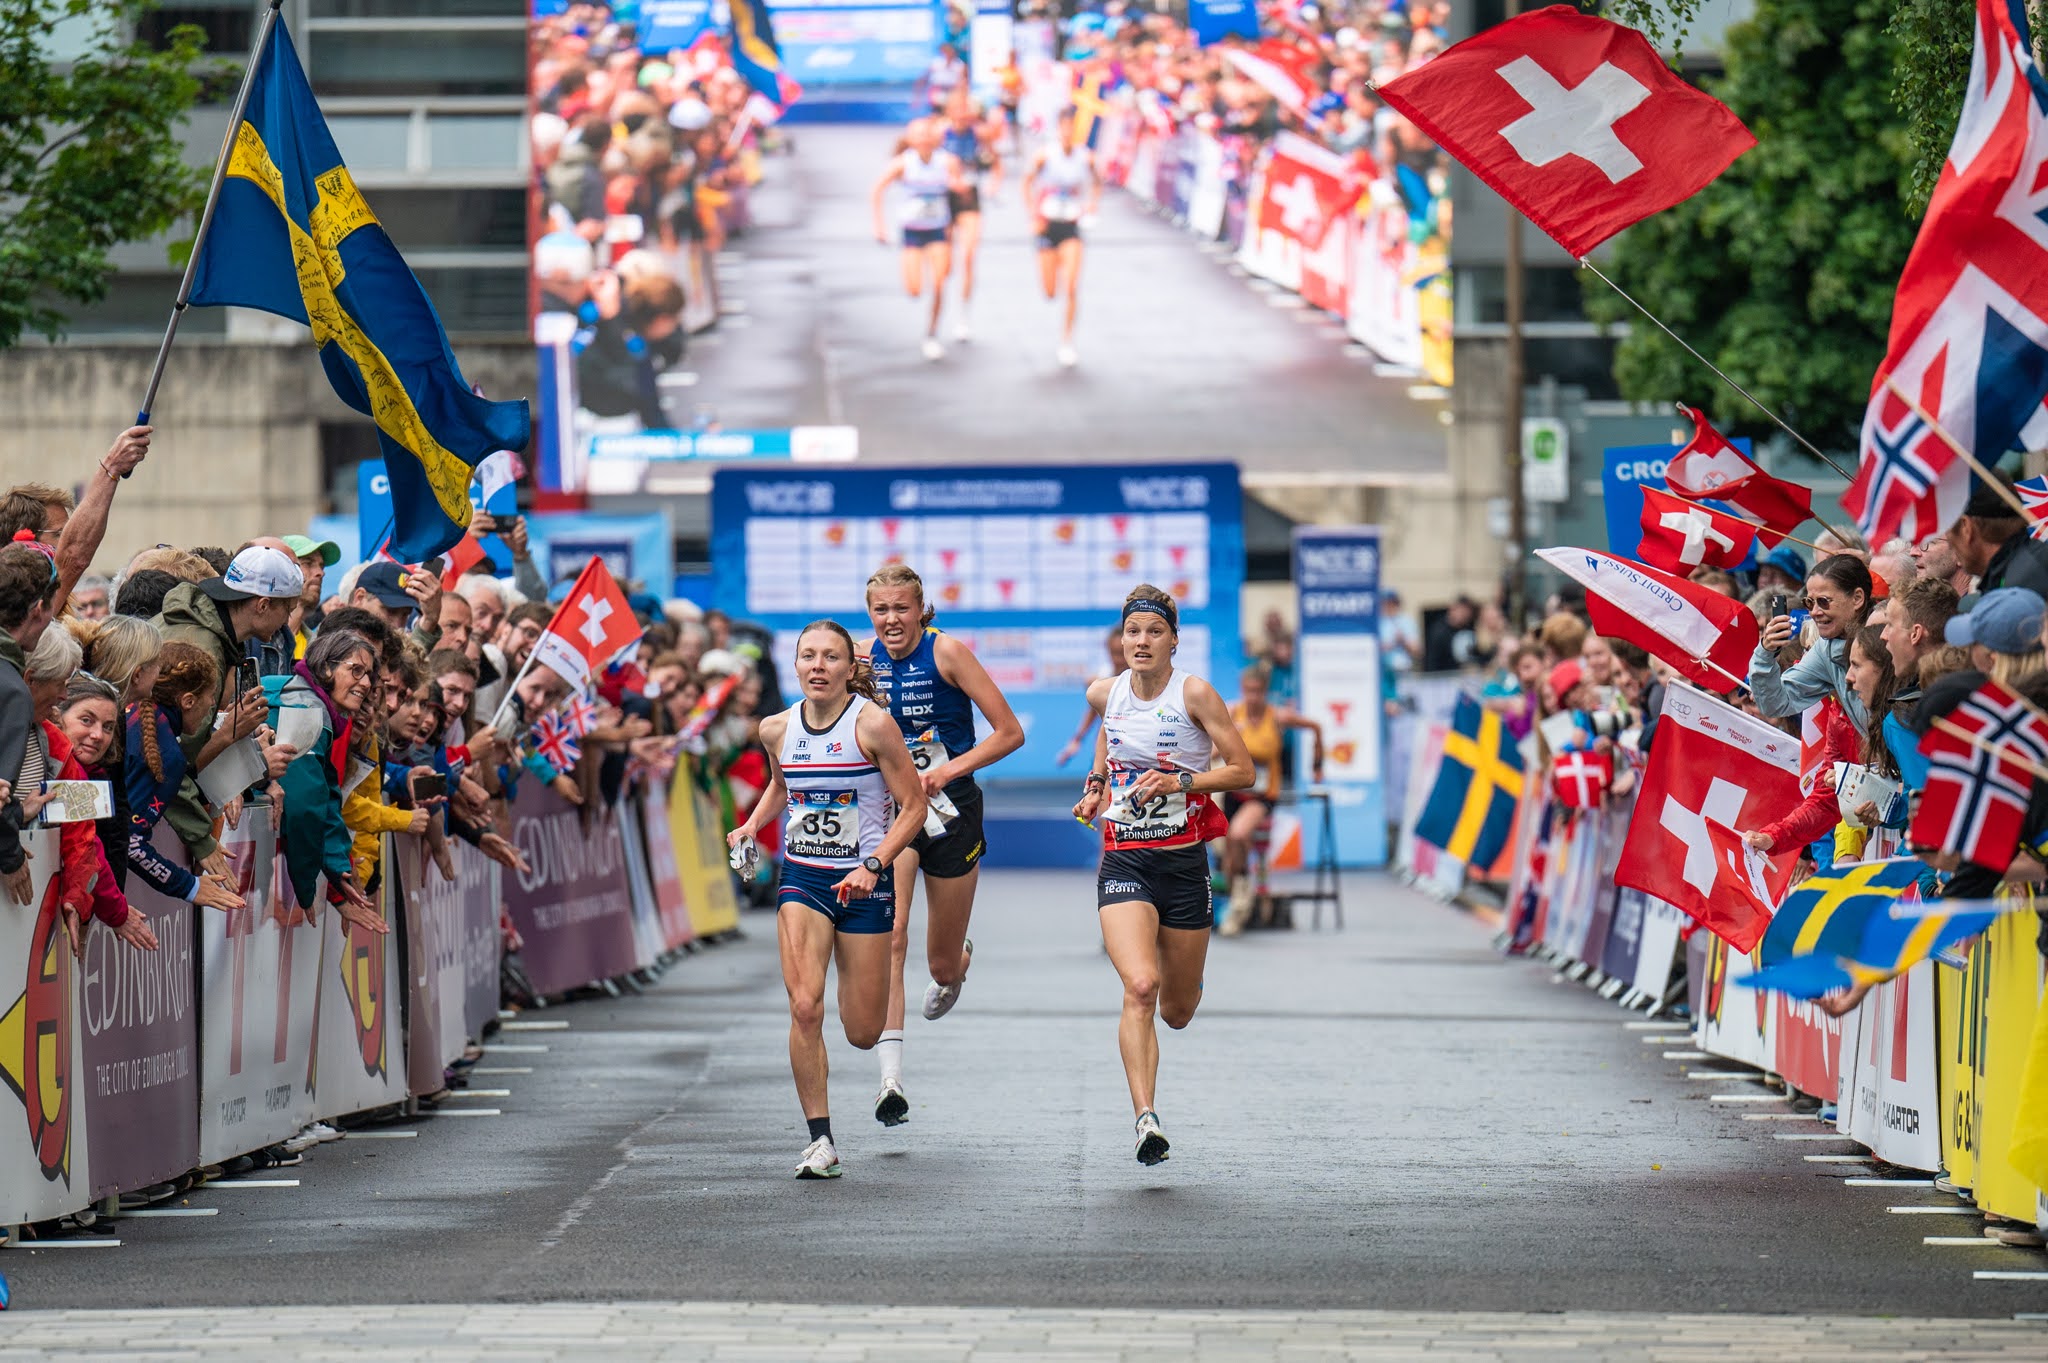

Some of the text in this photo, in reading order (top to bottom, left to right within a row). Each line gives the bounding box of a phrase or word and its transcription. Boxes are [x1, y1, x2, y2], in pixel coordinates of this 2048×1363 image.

[1615, 460, 1667, 481] CRO
[1601, 558, 1683, 612] CREDIT SUISSE
[901, 691, 934, 702] Folksam
[902, 704, 934, 716] BDX
[1161, 715, 1180, 723] EGK
[792, 753, 811, 761] FRANCE
[802, 811, 842, 837] 35
[1123, 828, 1178, 840] EDINBURGH
[795, 844, 849, 857] EDINBURGH
[96, 1064, 111, 1097] THE
[112, 1060, 129, 1095] CITY
[131, 1057, 141, 1091] OF
[142, 1050, 176, 1089] EDINBURGH
